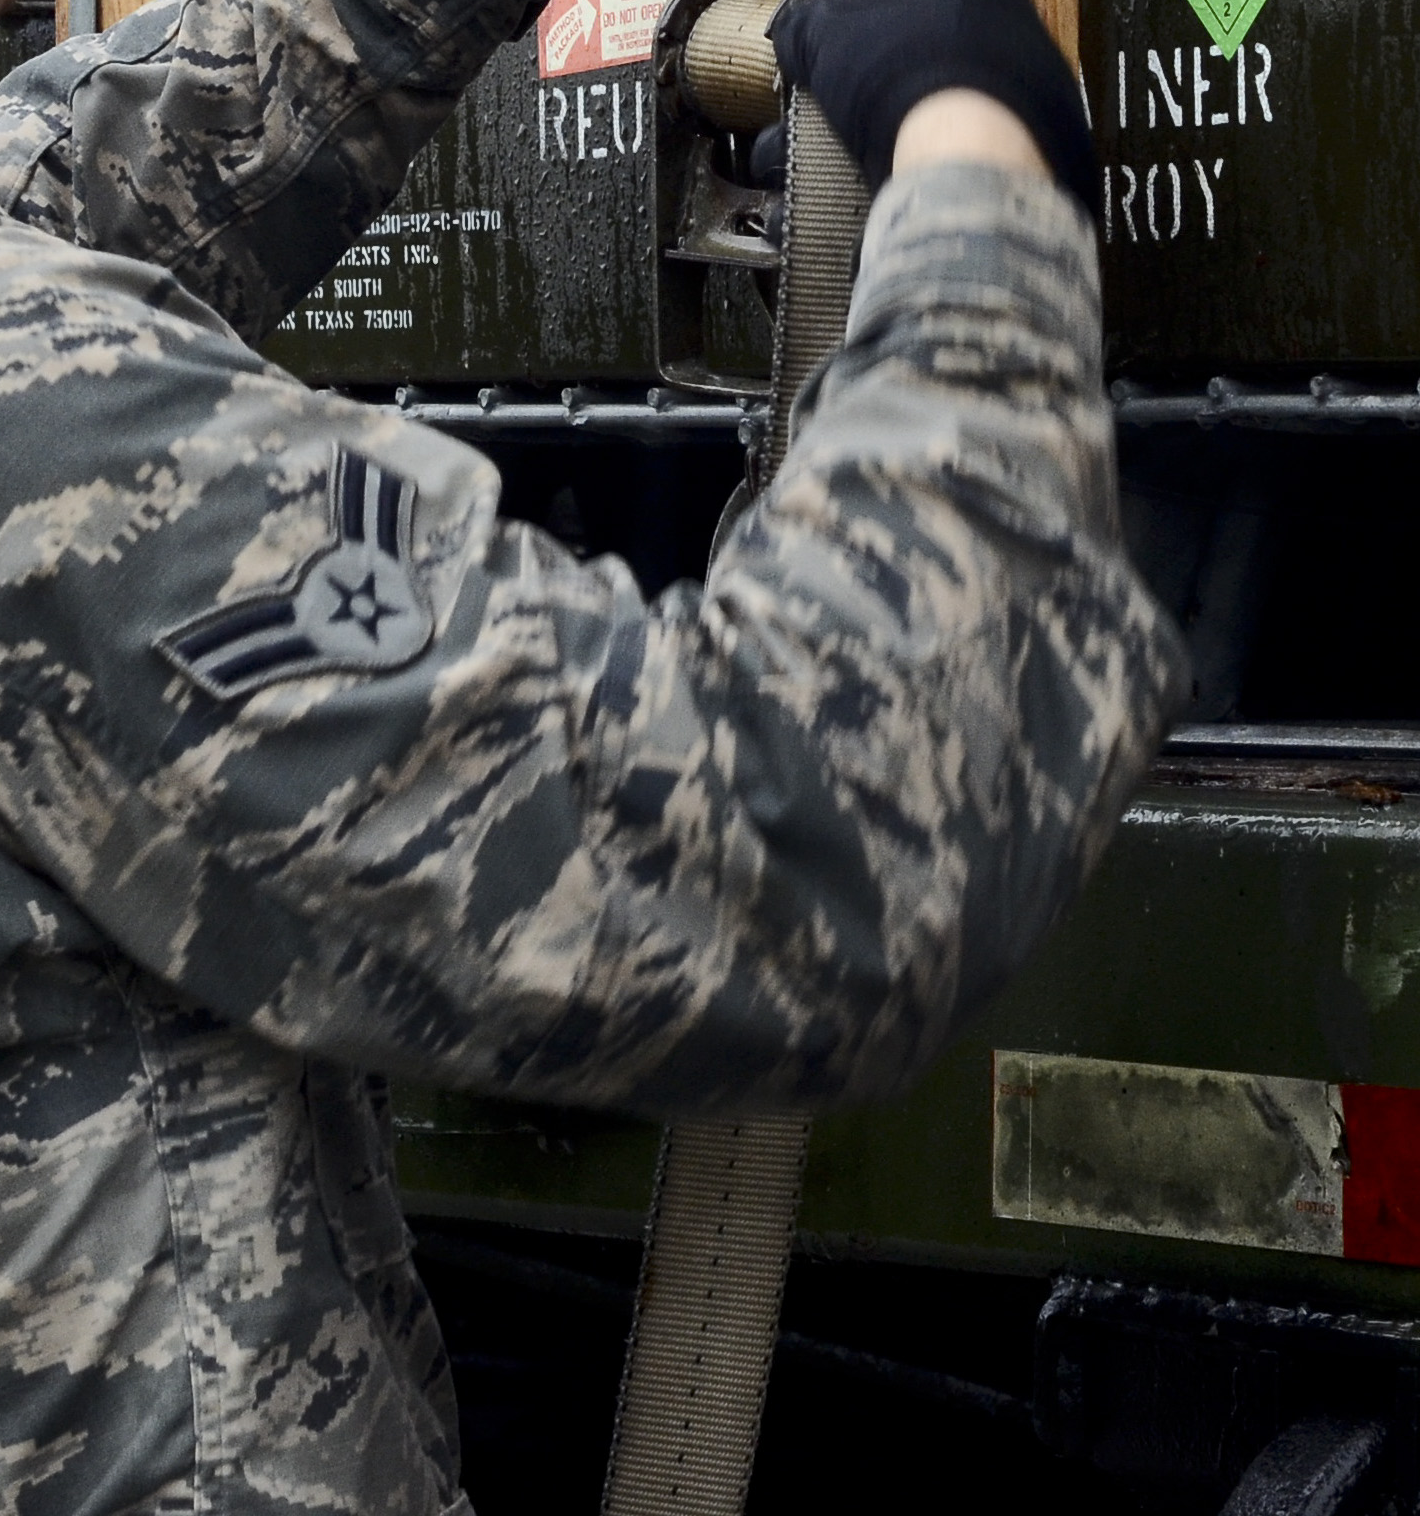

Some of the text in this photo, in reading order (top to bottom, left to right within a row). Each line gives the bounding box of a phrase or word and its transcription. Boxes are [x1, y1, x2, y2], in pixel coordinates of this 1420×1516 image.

[603, 12, 616, 28] DO
[620, 7, 637, 24] NOT
[1224, 2, 1231, 17] 2
[555, 19, 583, 60] PACKAGE
[538, 81, 642, 161] REU
[1104, 158, 1224, 243] ROY
[404, 245, 439, 265] INC.
[334, 278, 382, 298] SOUTH
[306, 310, 354, 330] TEXAS
[363, 309, 412, 330] 75090
